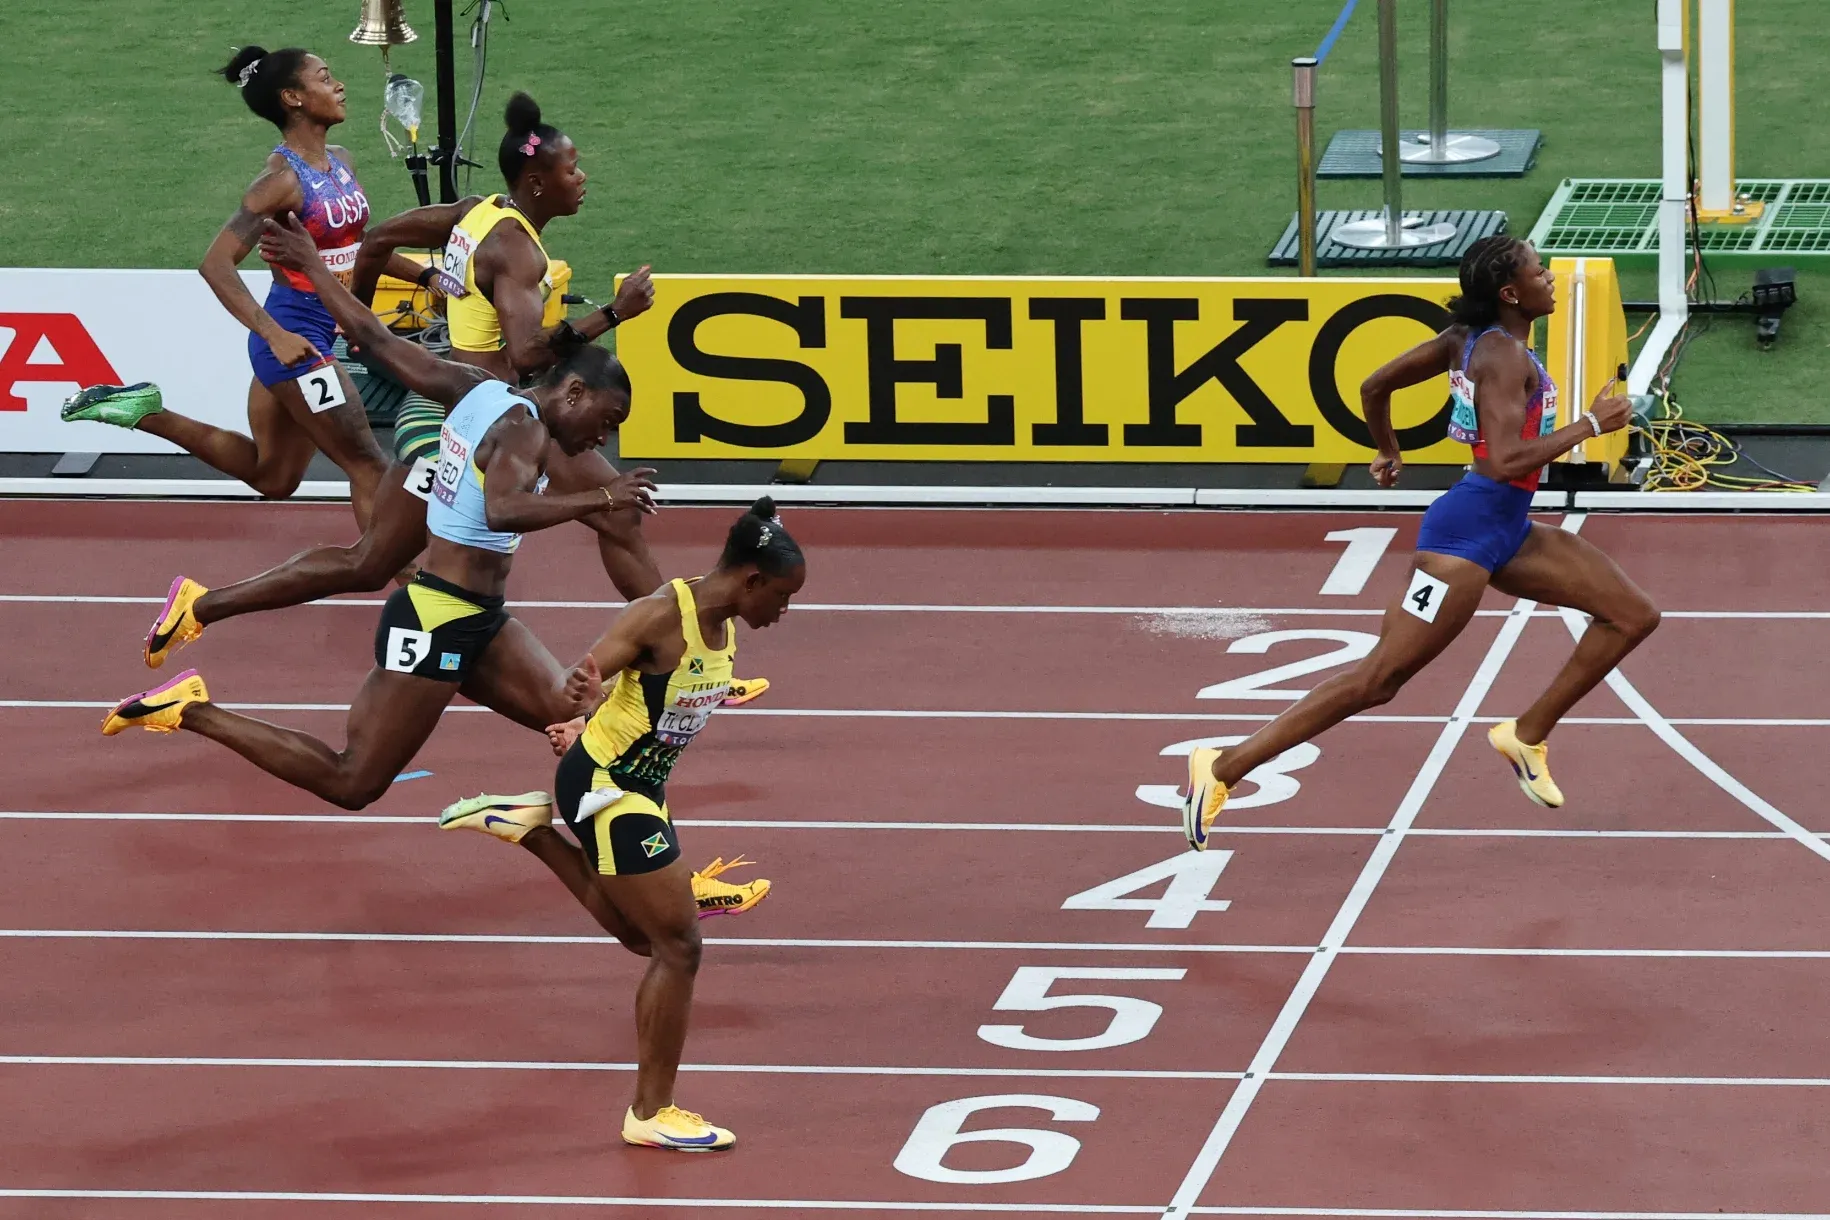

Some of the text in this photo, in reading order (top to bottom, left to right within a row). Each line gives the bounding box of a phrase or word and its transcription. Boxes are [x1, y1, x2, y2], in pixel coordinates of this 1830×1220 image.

[323, 190, 370, 229] USA
[310, 377, 335, 406] 2
[667, 292, 1454, 452] SEIKO
[417, 467, 437, 494] 3
[1318, 527, 1399, 595] 1
[1411, 584, 1434, 612] 4
[398, 636, 418, 667] 5
[1195, 629, 1381, 700] 2
[676, 690, 728, 708] HOND
[1135, 735, 1321, 810] 3
[1060, 849, 1235, 929] 4
[977, 966, 1188, 1051] 5
[893, 1094, 1100, 1184] 6
